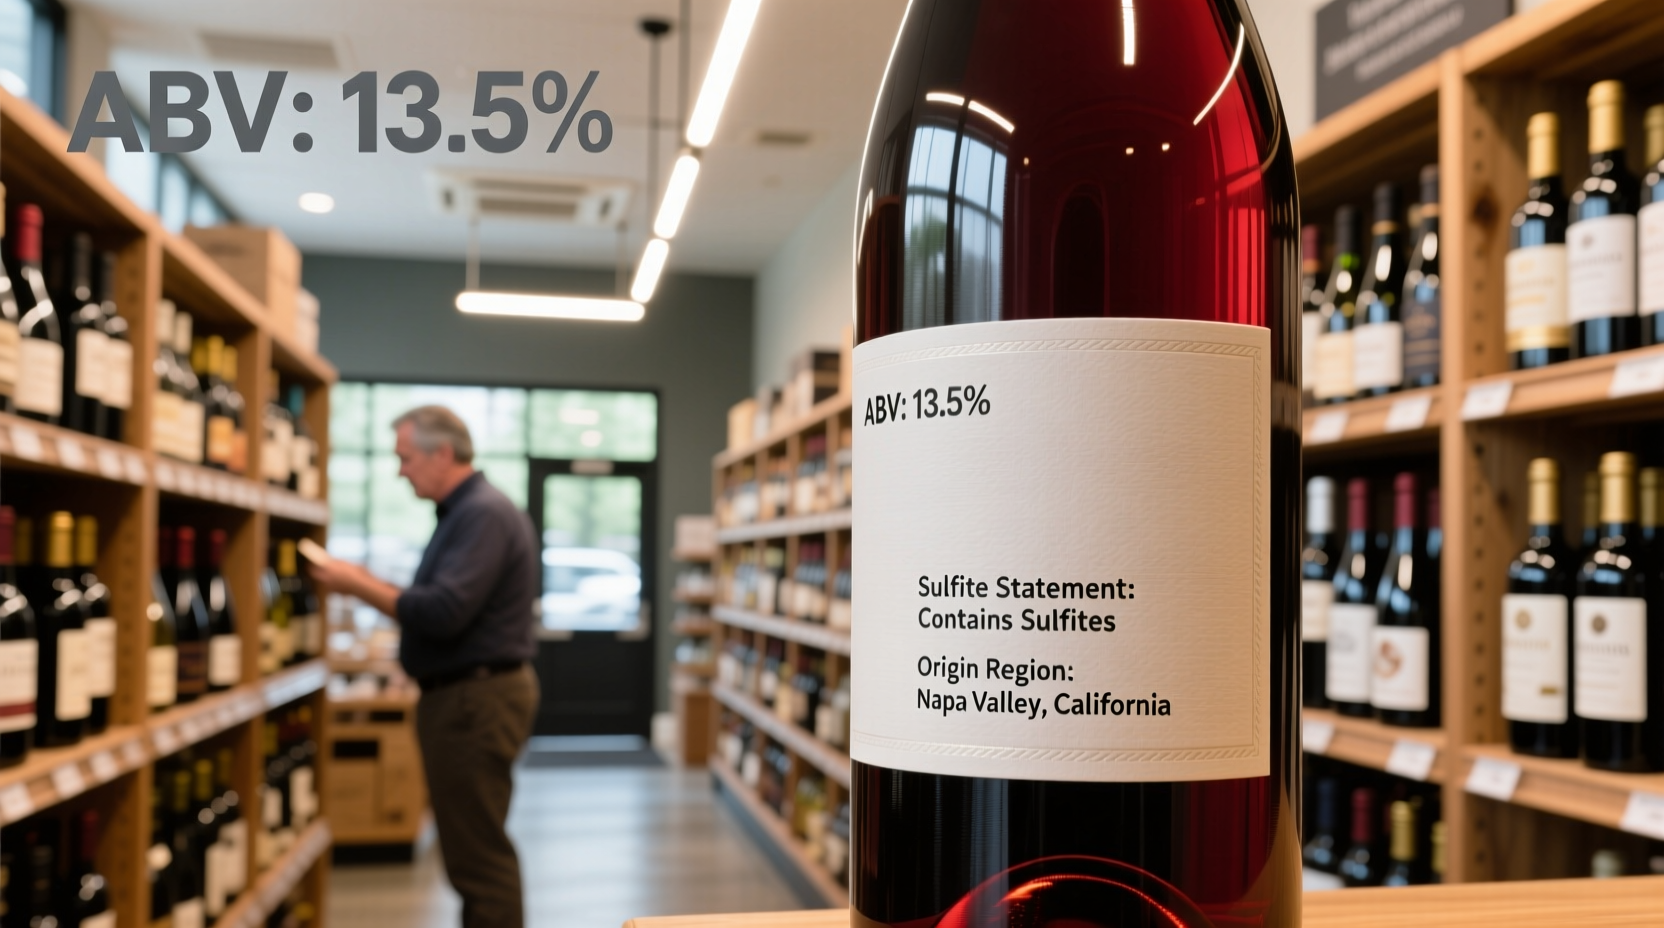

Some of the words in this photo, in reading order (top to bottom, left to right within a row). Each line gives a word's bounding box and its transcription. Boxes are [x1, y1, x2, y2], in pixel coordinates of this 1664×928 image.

[864, 391, 907, 427] ABV:
[913, 384, 991, 418] 13.5%
[918, 574, 989, 598] Sulfite
[996, 576, 1135, 600] Statement:
[918, 607, 1013, 631] Contains
[1021, 607, 1116, 632] Sulfites
[918, 655, 979, 684] Origin
[986, 658, 1074, 685] Region:
[917, 687, 967, 717] Napa
[971, 690, 1048, 721] Valley,
[1054, 691, 1172, 717] California
